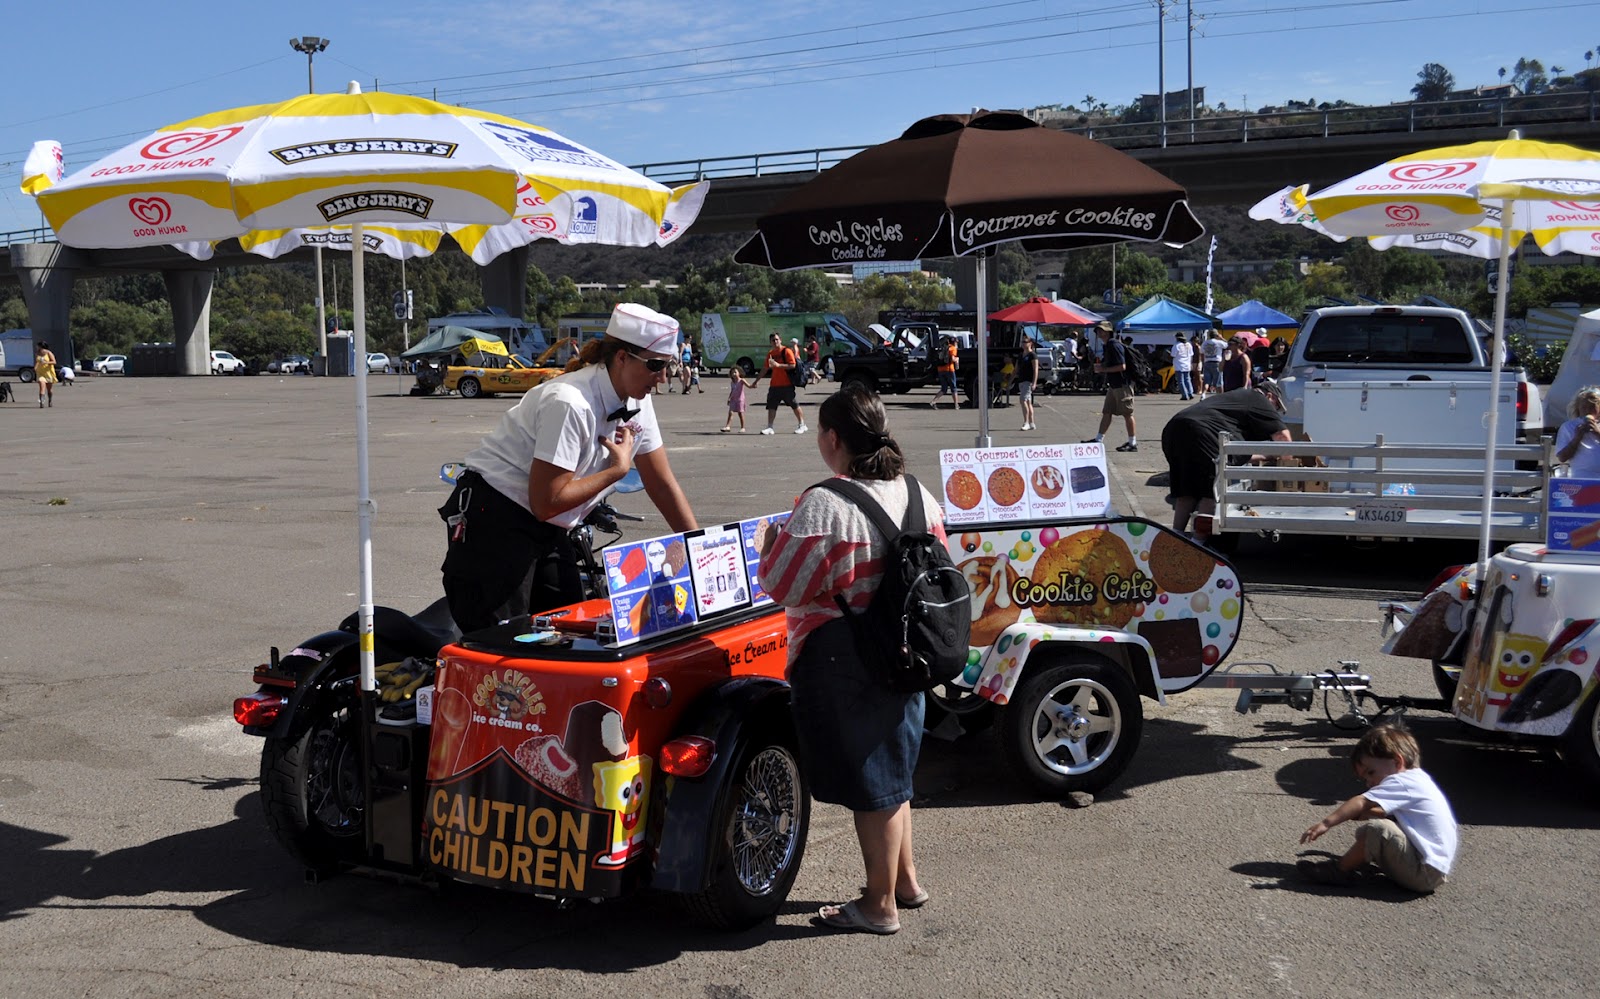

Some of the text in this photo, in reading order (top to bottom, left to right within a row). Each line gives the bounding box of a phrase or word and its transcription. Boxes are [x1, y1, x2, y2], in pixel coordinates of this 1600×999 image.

[90, 157, 214, 177] GOOD HUMOR
[1355, 182, 1466, 192] GOOD HUMOR
[133, 225, 188, 237] GOOD HUMOR
[808, 217, 904, 245] Cool Cycles
[959, 207, 1157, 242] Gourmet Cookies
[831, 244, 887, 260] Cookie Cafe
[943, 446, 1100, 463] $3.00 Gourmet Cookies $3.00
[1358, 510, 1403, 522] 4KS4619
[1012, 572, 1153, 605] Cookie Cafe
[744, 641, 777, 664] Cream
[472, 669, 546, 715] COOL CYCLES
[473, 711, 543, 733] ice cream co.
[432, 789, 590, 851] CAUTION
[430, 827, 587, 891] CHILDREN
